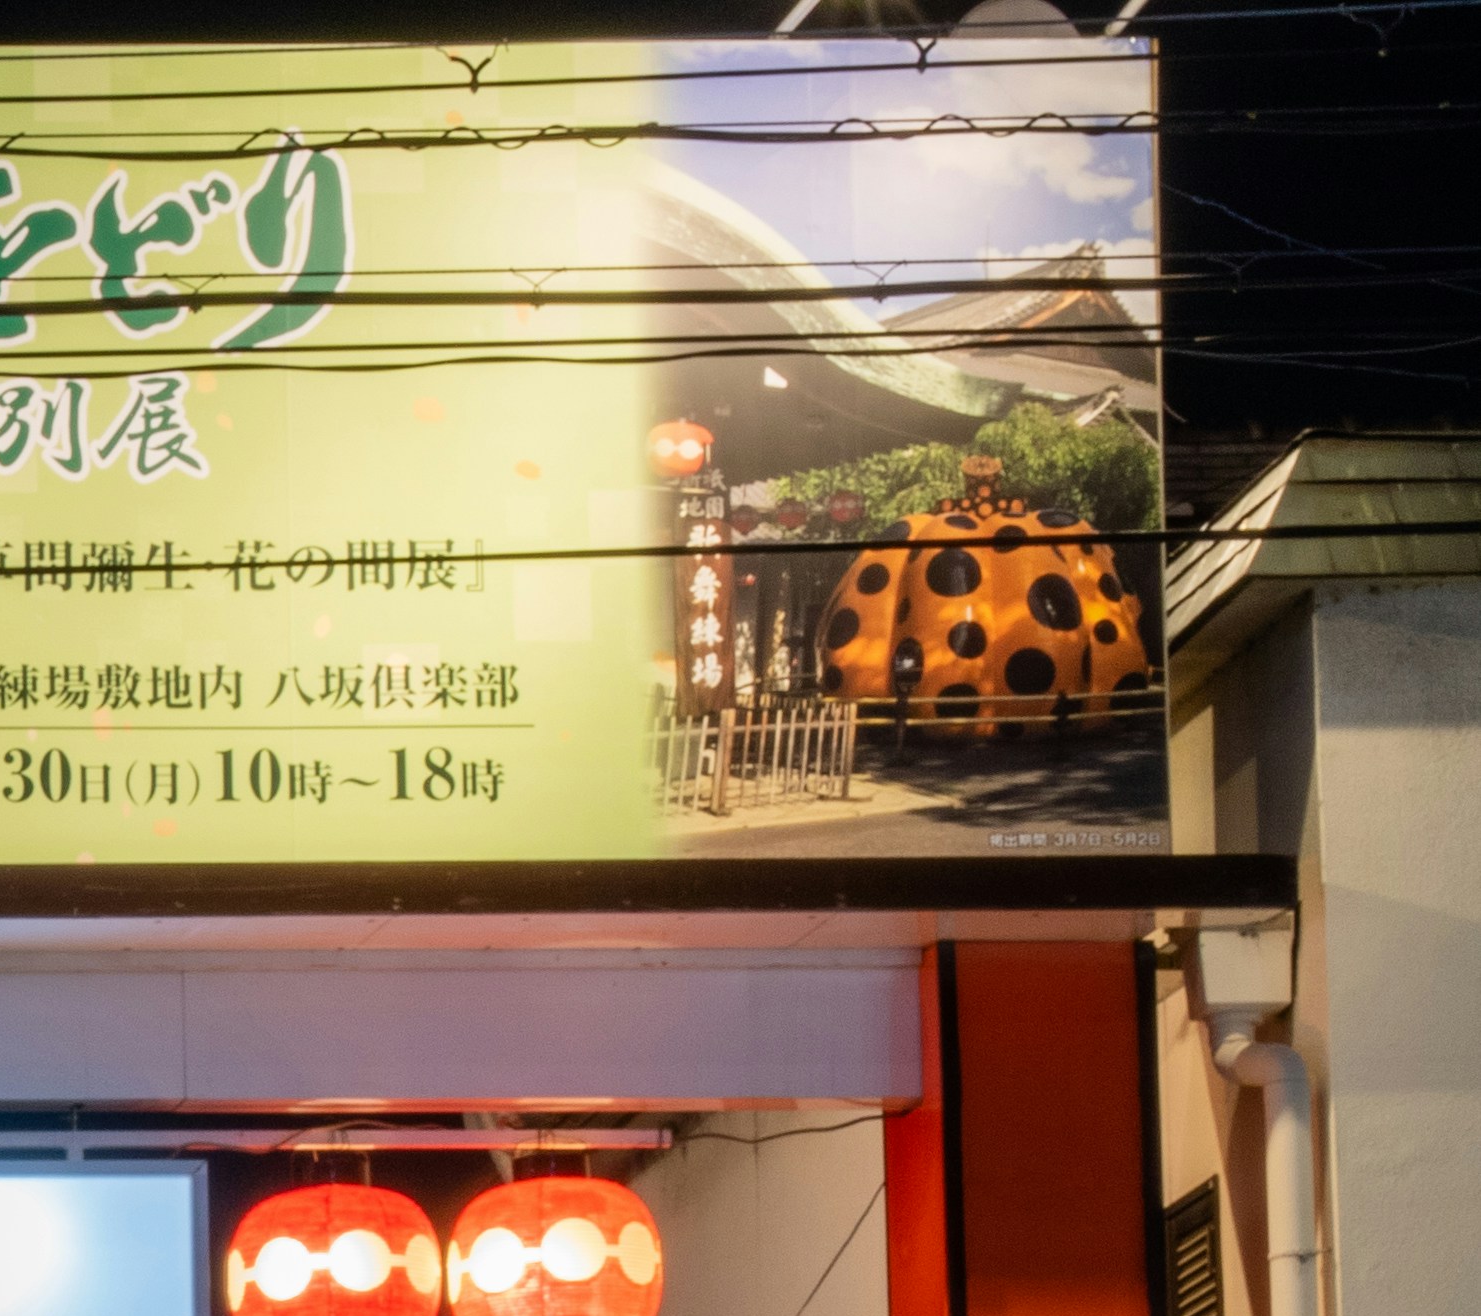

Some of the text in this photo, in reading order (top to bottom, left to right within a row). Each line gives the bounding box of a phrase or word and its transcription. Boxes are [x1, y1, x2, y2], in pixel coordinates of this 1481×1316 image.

[265, 662, 521, 710] 八坂倶楽部
